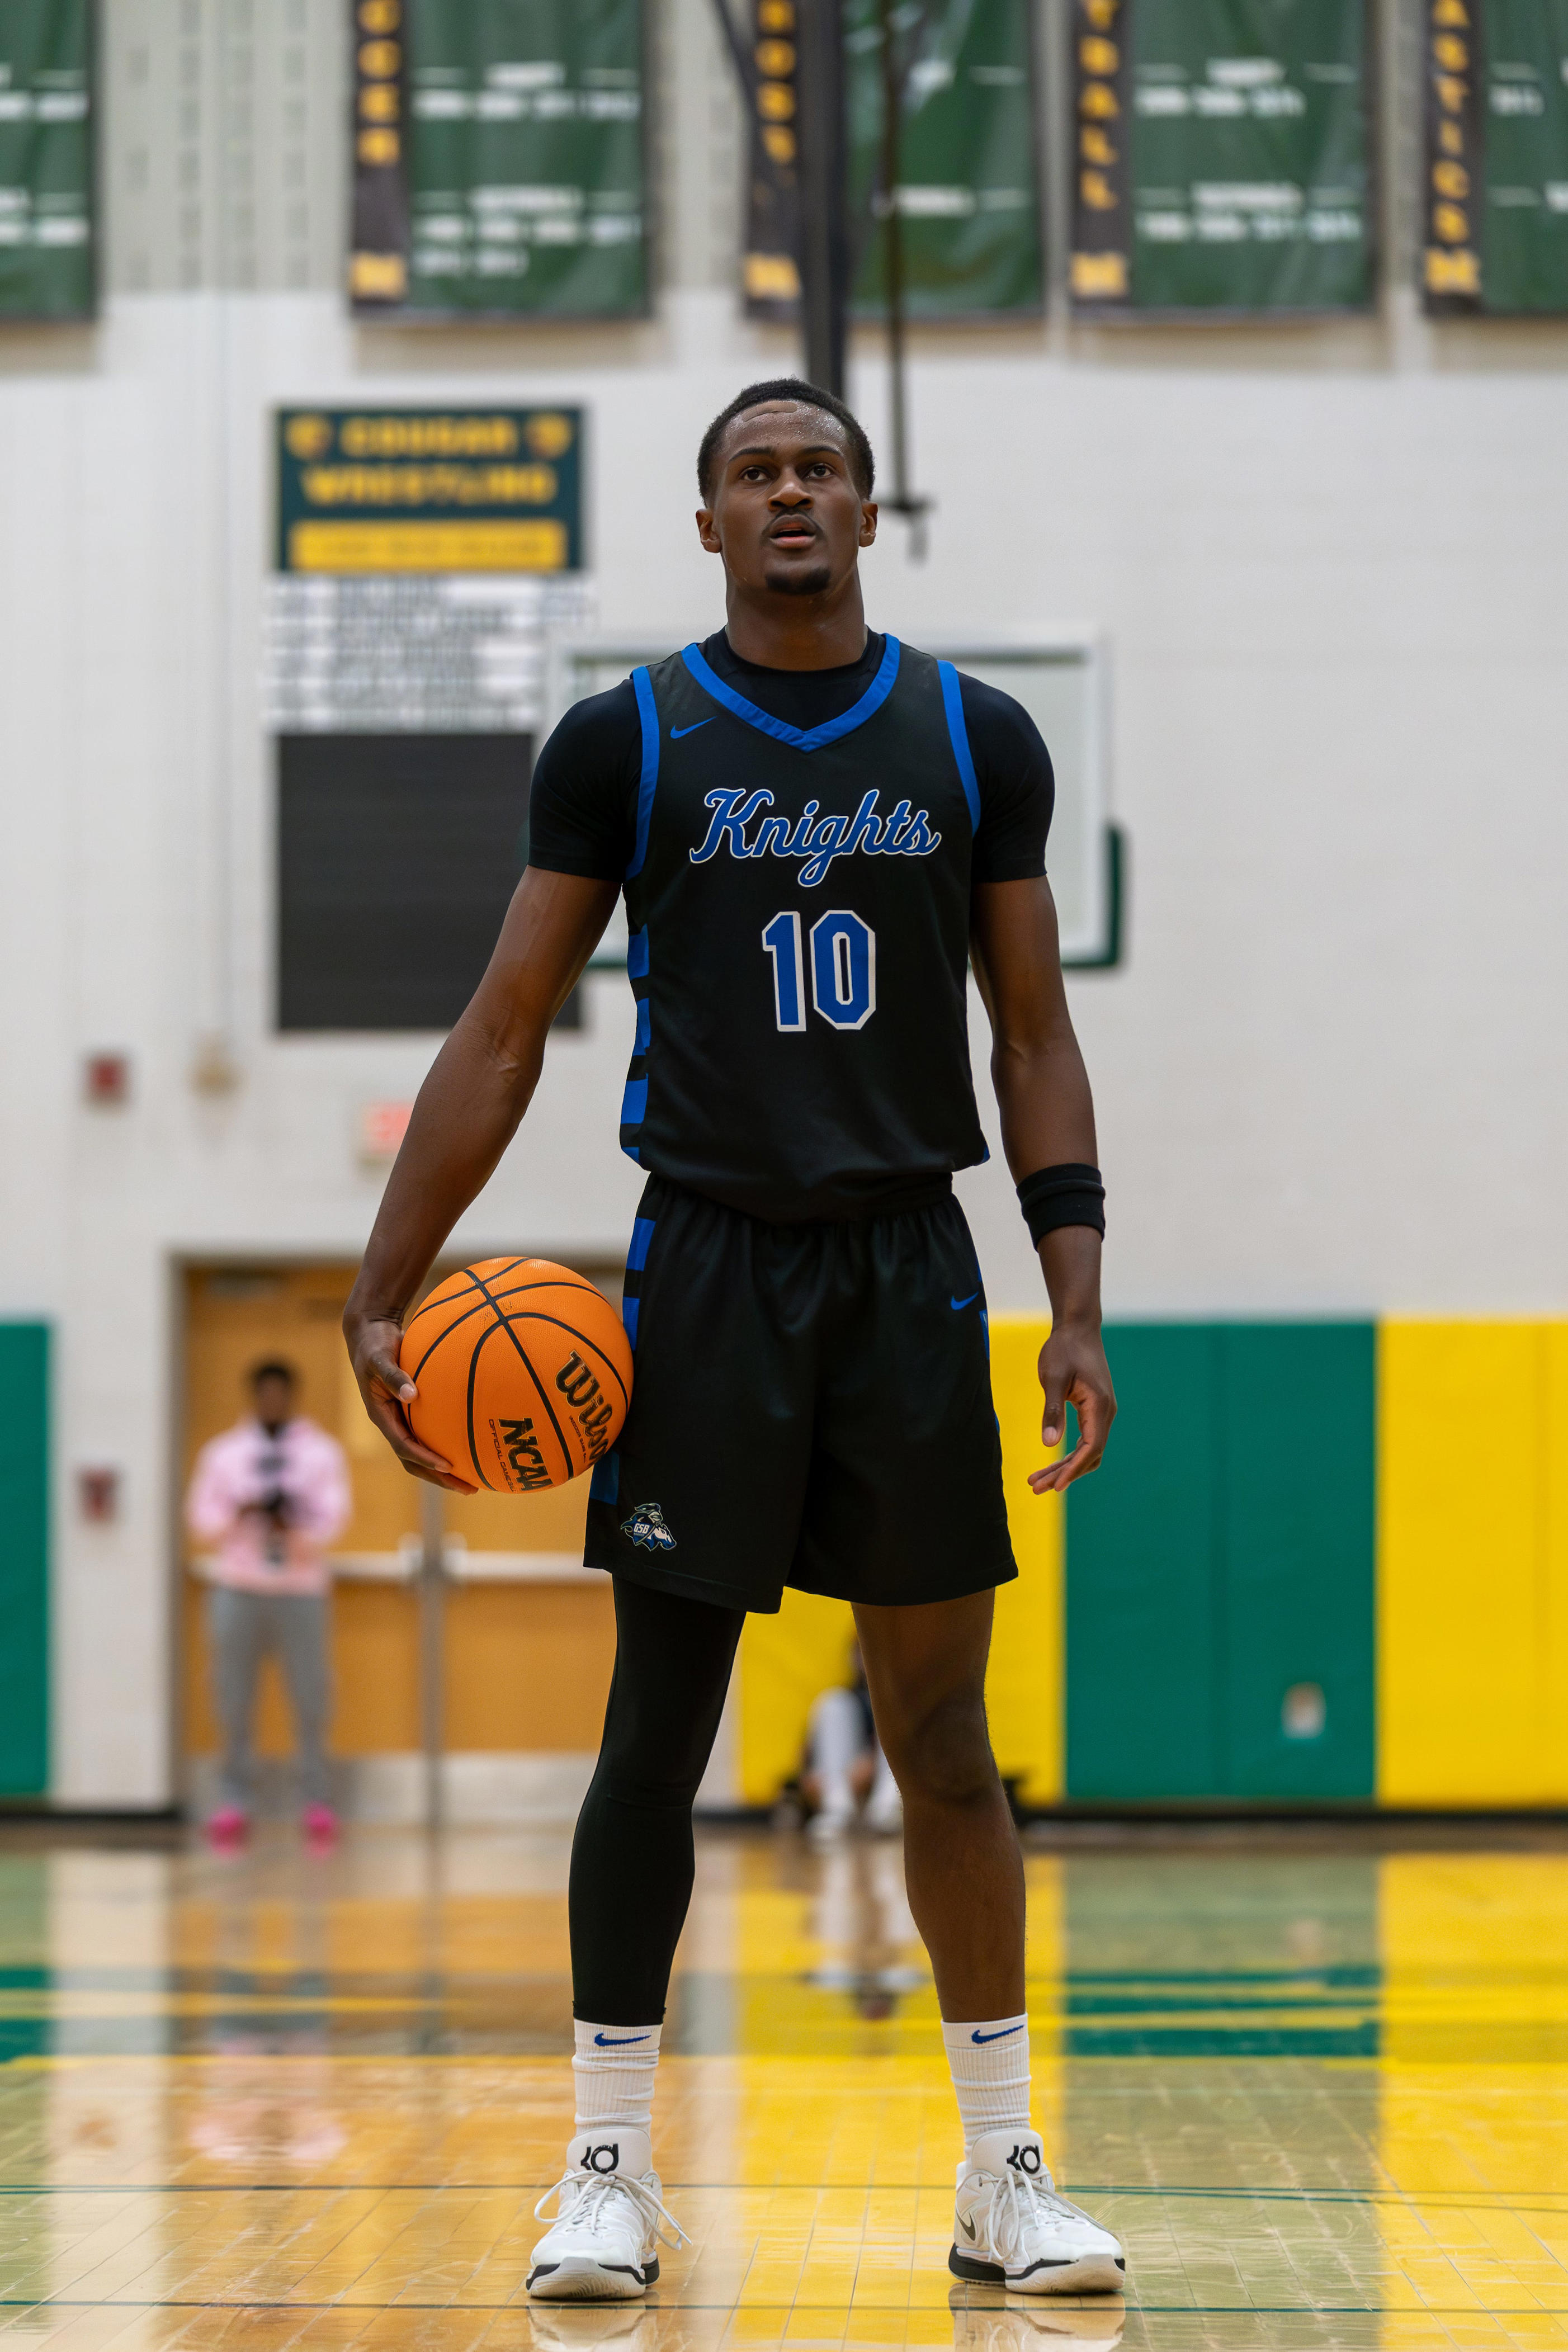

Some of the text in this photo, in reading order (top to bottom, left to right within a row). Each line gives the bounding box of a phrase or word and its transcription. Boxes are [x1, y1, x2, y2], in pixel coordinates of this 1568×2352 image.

[689, 787, 942, 887] Knights
[762, 909, 876, 1032] 10
[489, 1419, 503, 1461] OFFICIAL
[555, 1349, 613, 1462] Wilso
[498, 1418, 553, 1491] NCAA
[634, 1523, 650, 1534] GSB
